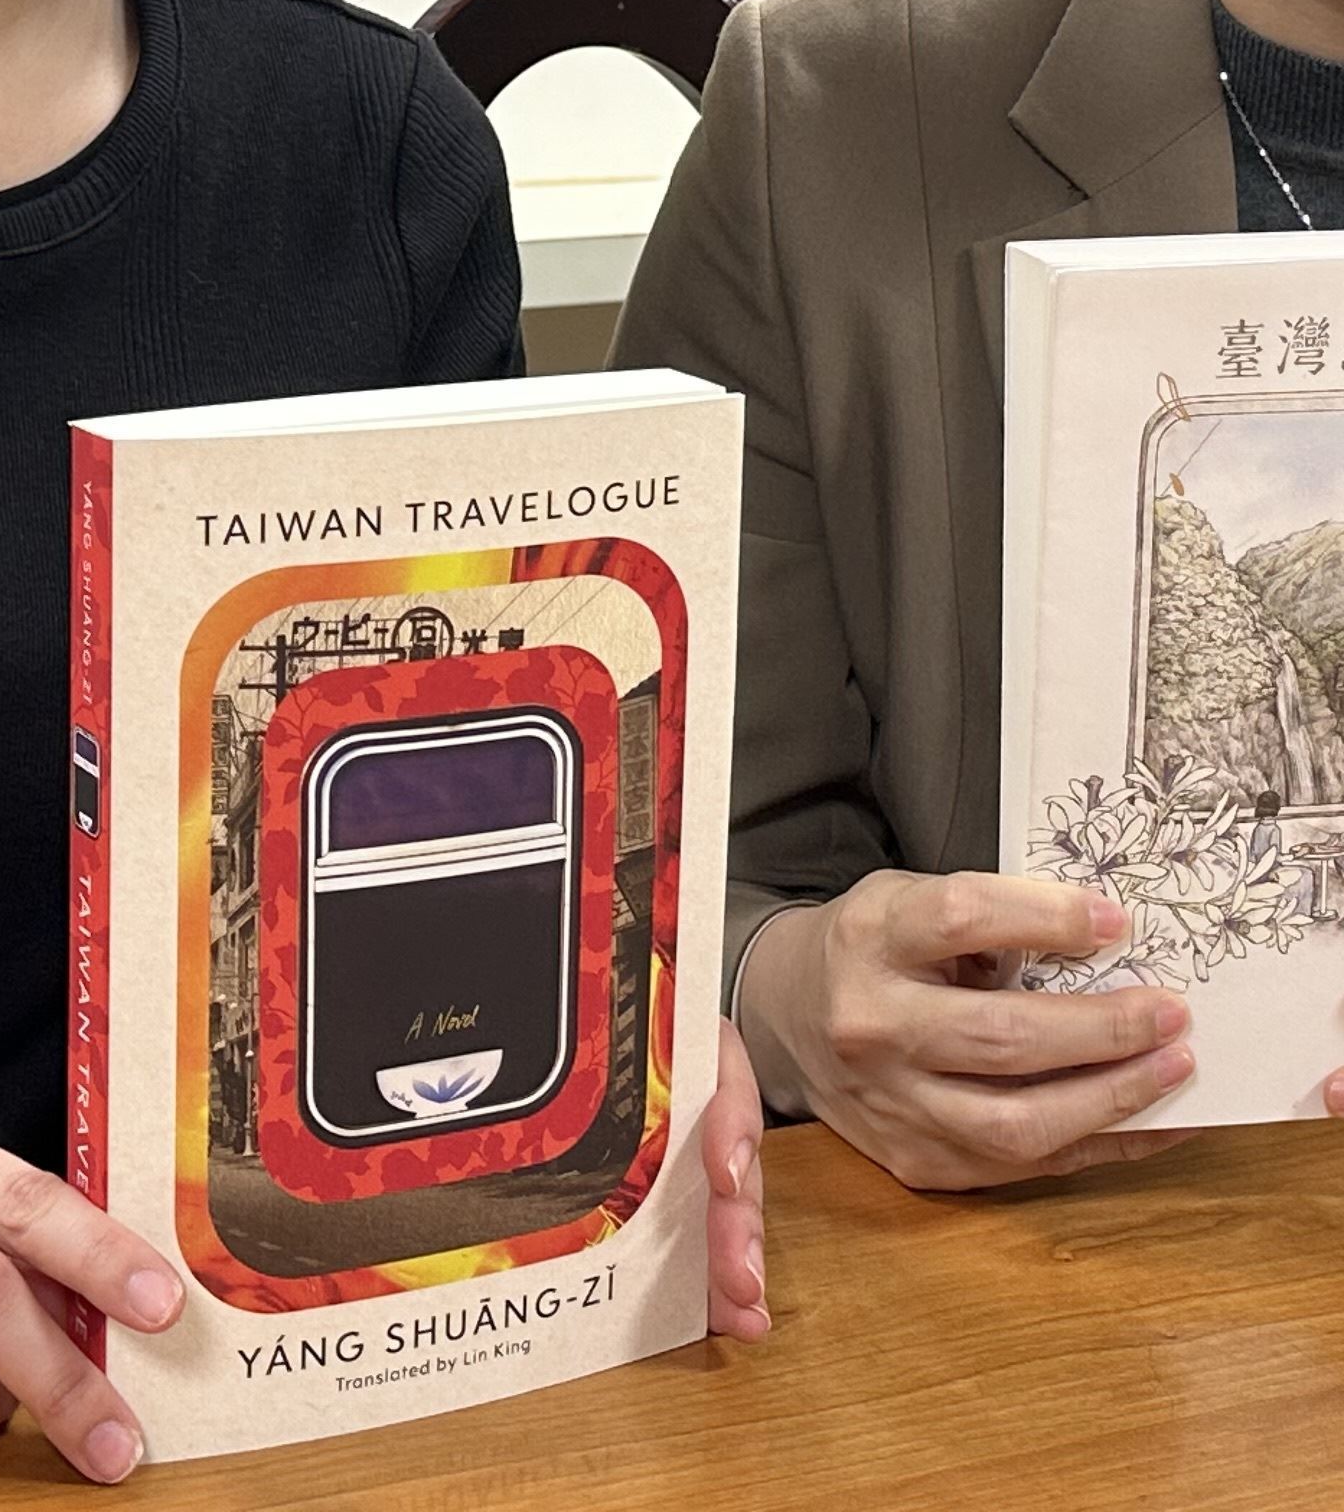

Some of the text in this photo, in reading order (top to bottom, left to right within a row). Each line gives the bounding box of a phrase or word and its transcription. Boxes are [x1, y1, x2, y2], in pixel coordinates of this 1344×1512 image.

[196, 475, 681, 547] TAIWAN TRAVELOGUE
[77, 874, 93, 1043] TAIWAN
[404, 1004, 481, 1045] A Novel
[238, 1330, 365, 1379] YÁNG
[335, 1337, 532, 1392] Translated by Lin King
